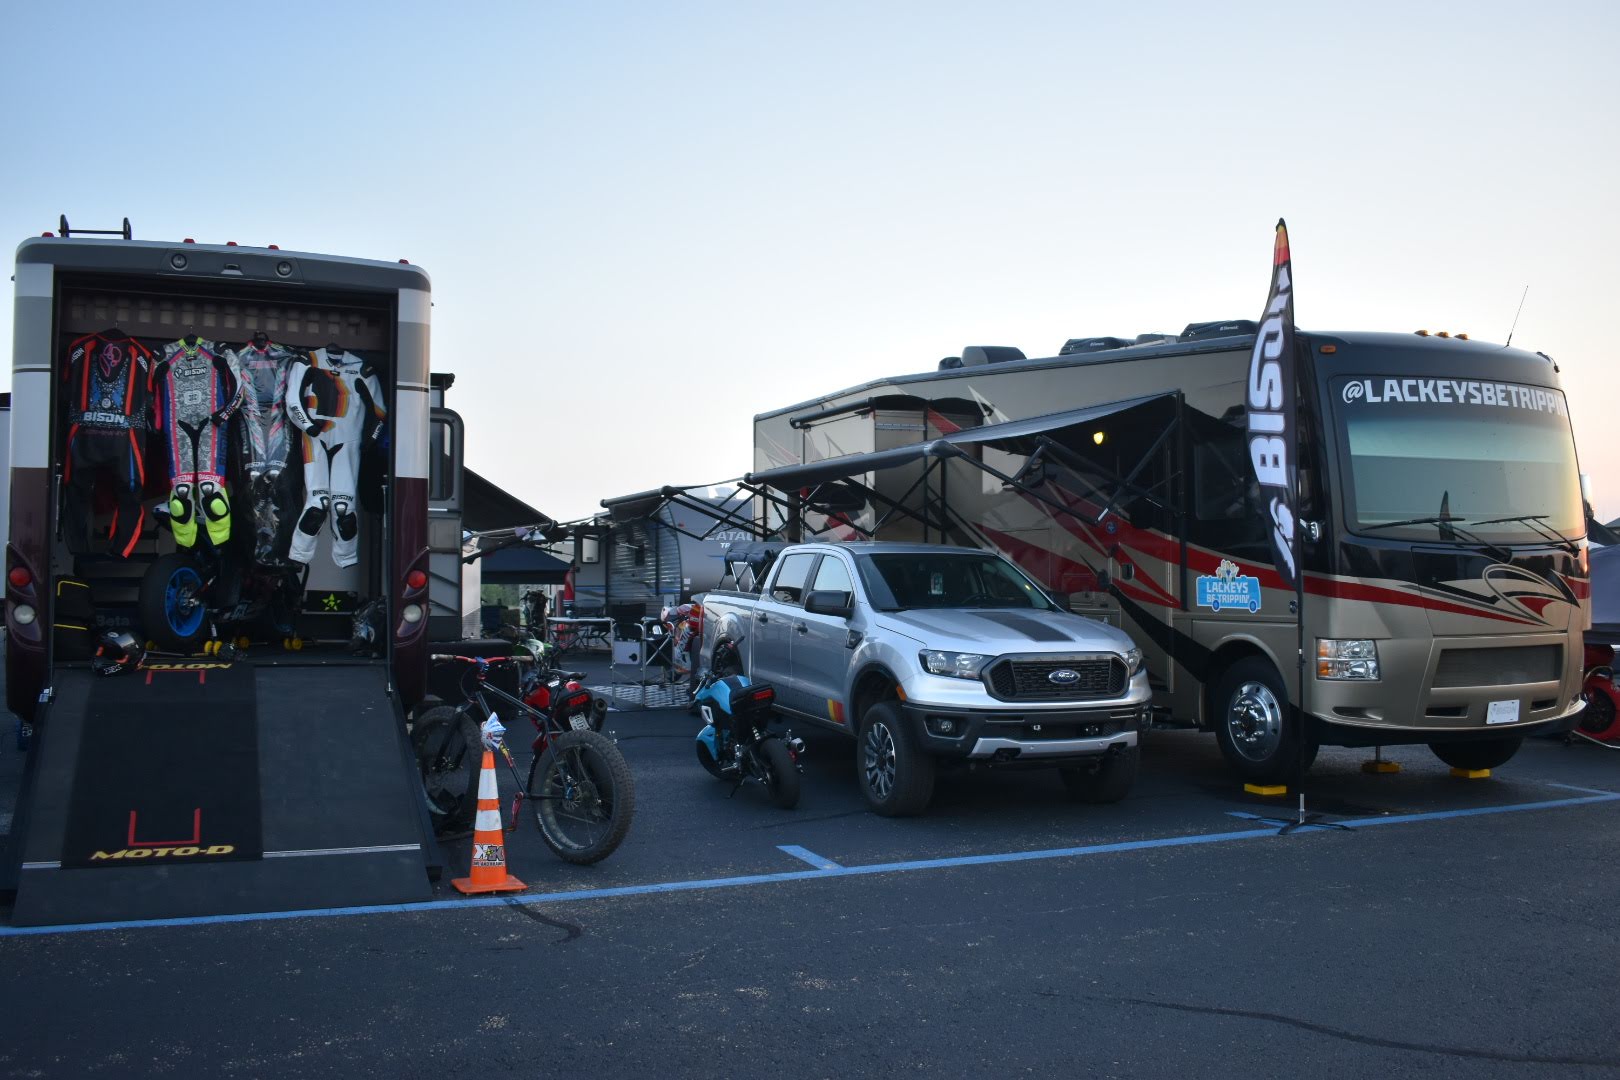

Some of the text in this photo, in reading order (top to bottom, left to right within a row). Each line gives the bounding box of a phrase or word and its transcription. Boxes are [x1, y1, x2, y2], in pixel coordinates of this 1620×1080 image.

[184, 367, 206, 377] BISON
[83, 412, 125, 424] BISON
[331, 494, 354, 502] BISON
[704, 531, 753, 541] ATAL
[1206, 581, 1249, 594] LACKEYS
[90, 845, 234, 860] MOTO-D
